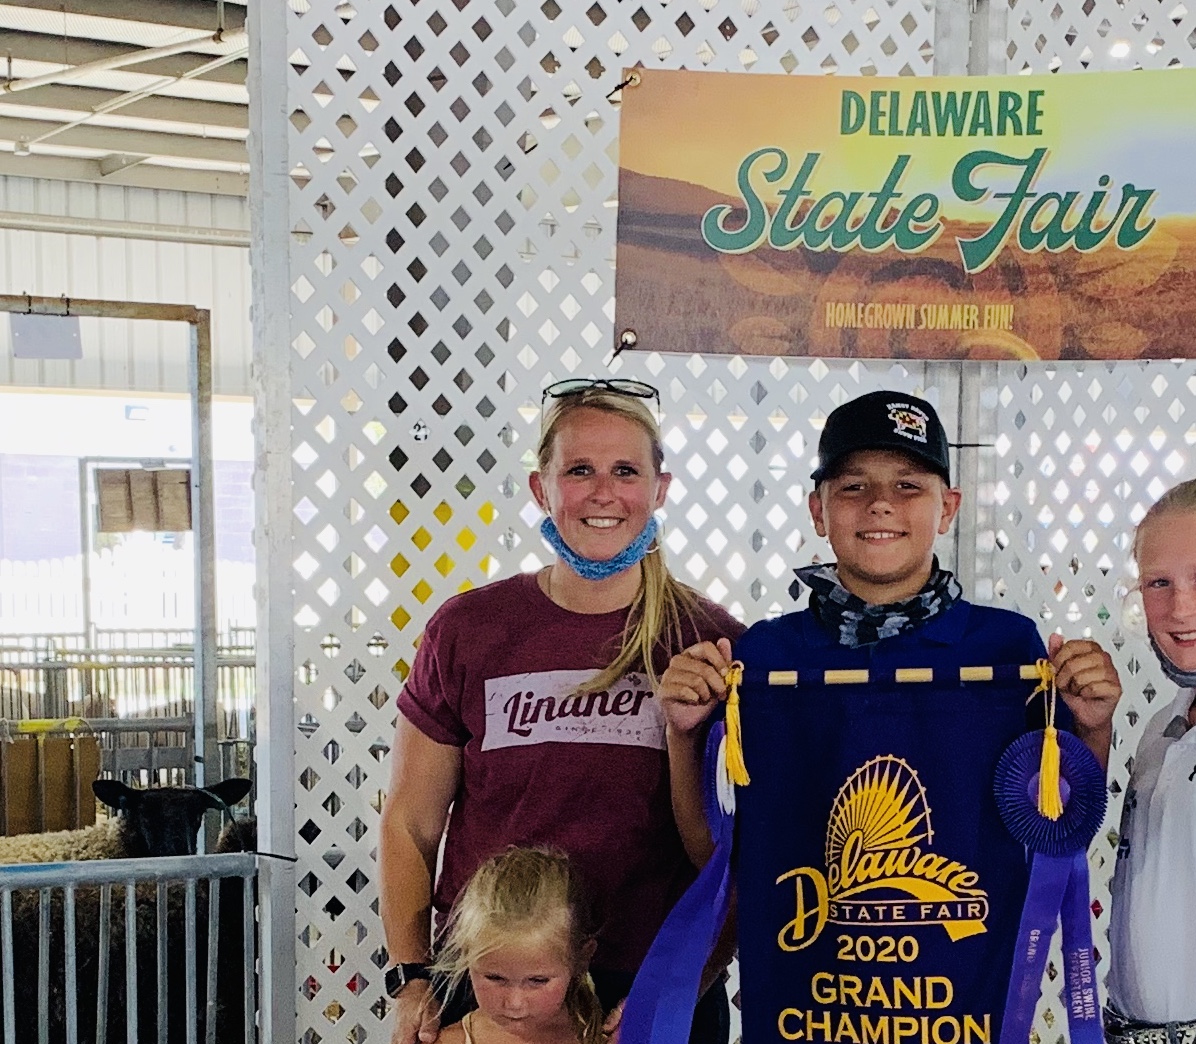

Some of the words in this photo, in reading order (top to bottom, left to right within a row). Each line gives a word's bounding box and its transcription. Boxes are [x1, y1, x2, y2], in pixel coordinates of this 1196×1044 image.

[840, 90, 1045, 136] DELAWARE
[701, 146, 945, 255] State
[951, 148, 1158, 273] Fair
[826, 302, 915, 329] HOMEGROWN
[918, 303, 979, 330] SUMMER
[984, 304, 1015, 330] FUN!
[776, 829, 989, 952] Delaware
[830, 904, 905, 920] STATE
[920, 903, 981, 919] FAIR
[837, 935, 919, 963] 2020
[1078, 947, 1091, 985] JUNIOR
[811, 972, 954, 1010] GRAND
[1082, 987, 1096, 1021] SWINE
